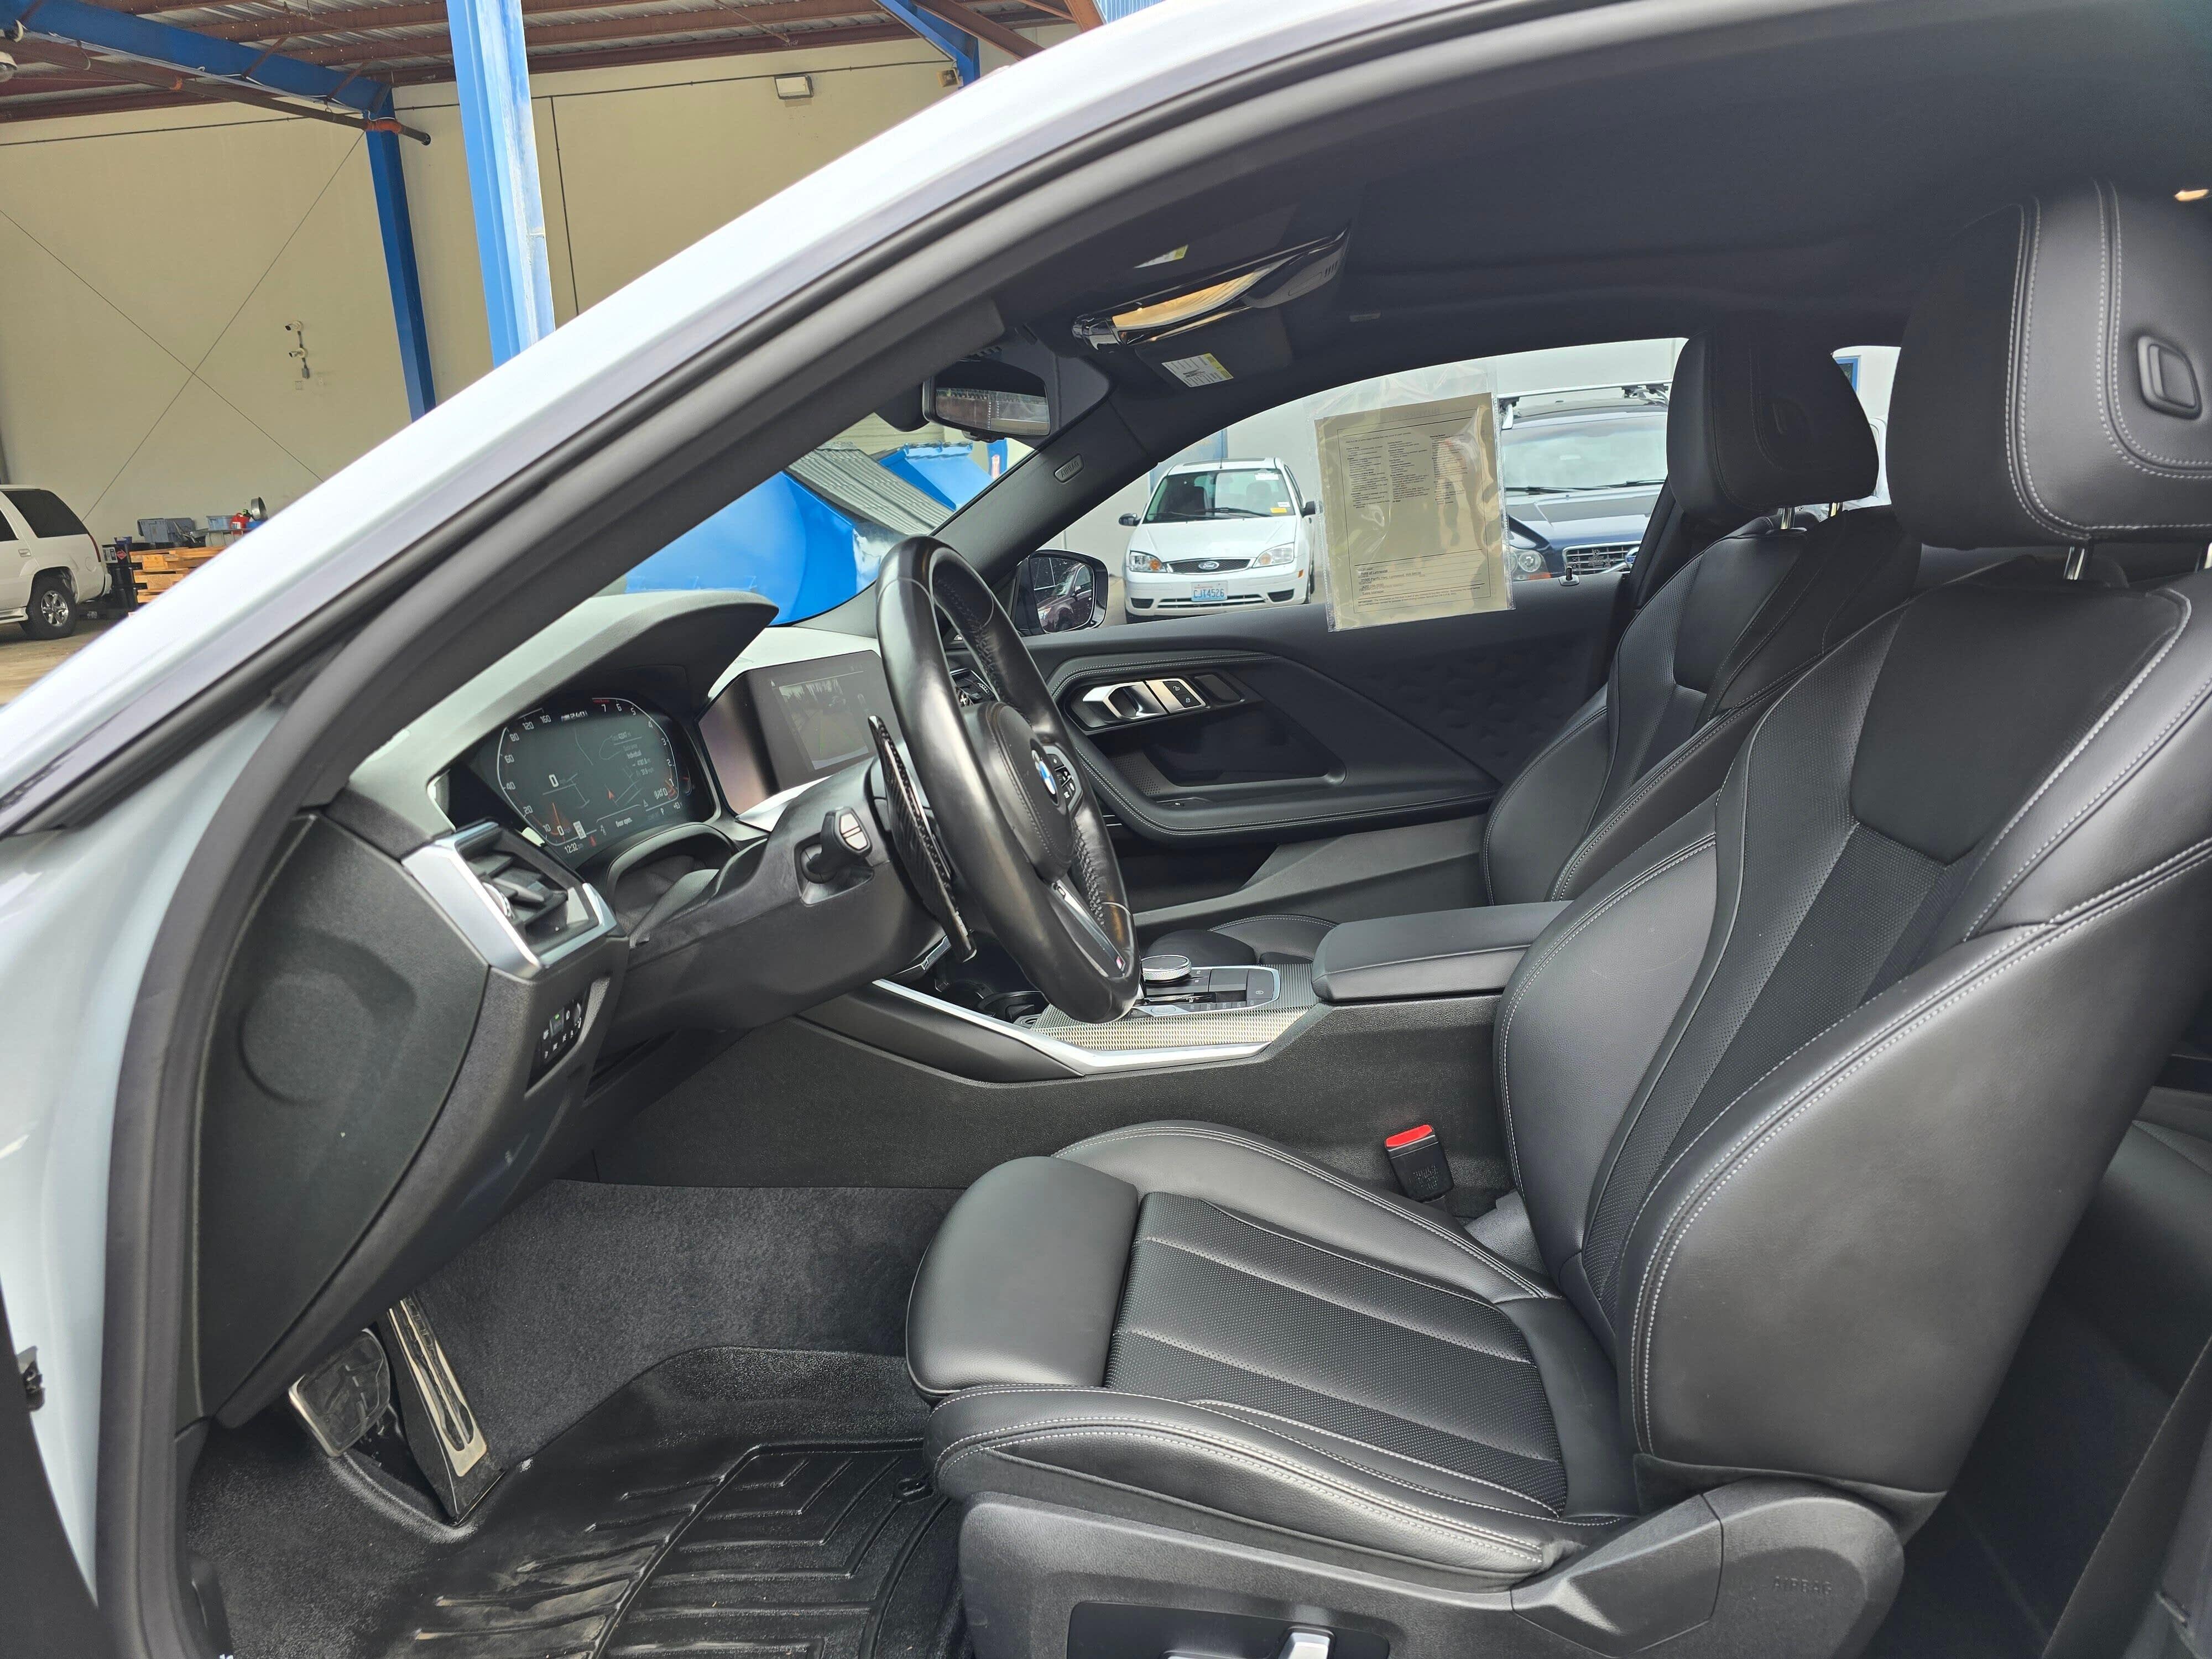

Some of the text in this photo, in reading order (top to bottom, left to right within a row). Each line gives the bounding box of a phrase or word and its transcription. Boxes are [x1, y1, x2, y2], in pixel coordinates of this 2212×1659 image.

[1061, 460, 1079, 478] AIRBAG
[1194, 588, 1224, 598] CJT4526
[616, 703, 622, 712] 6
[630, 707, 636, 716] 5
[540, 714, 551, 723] 160
[522, 721, 535, 730] 120
[509, 733, 519, 742] 80
[504, 754, 515, 764] 60
[549, 774, 559, 787] 0
[669, 778, 675, 786] 1
[506, 781, 516, 790] 40
[523, 805, 533, 815] 20
[542, 824, 551, 832] 10
[557, 826, 565, 836] 0
[1774, 1575, 1832, 1594] AIRBAG
